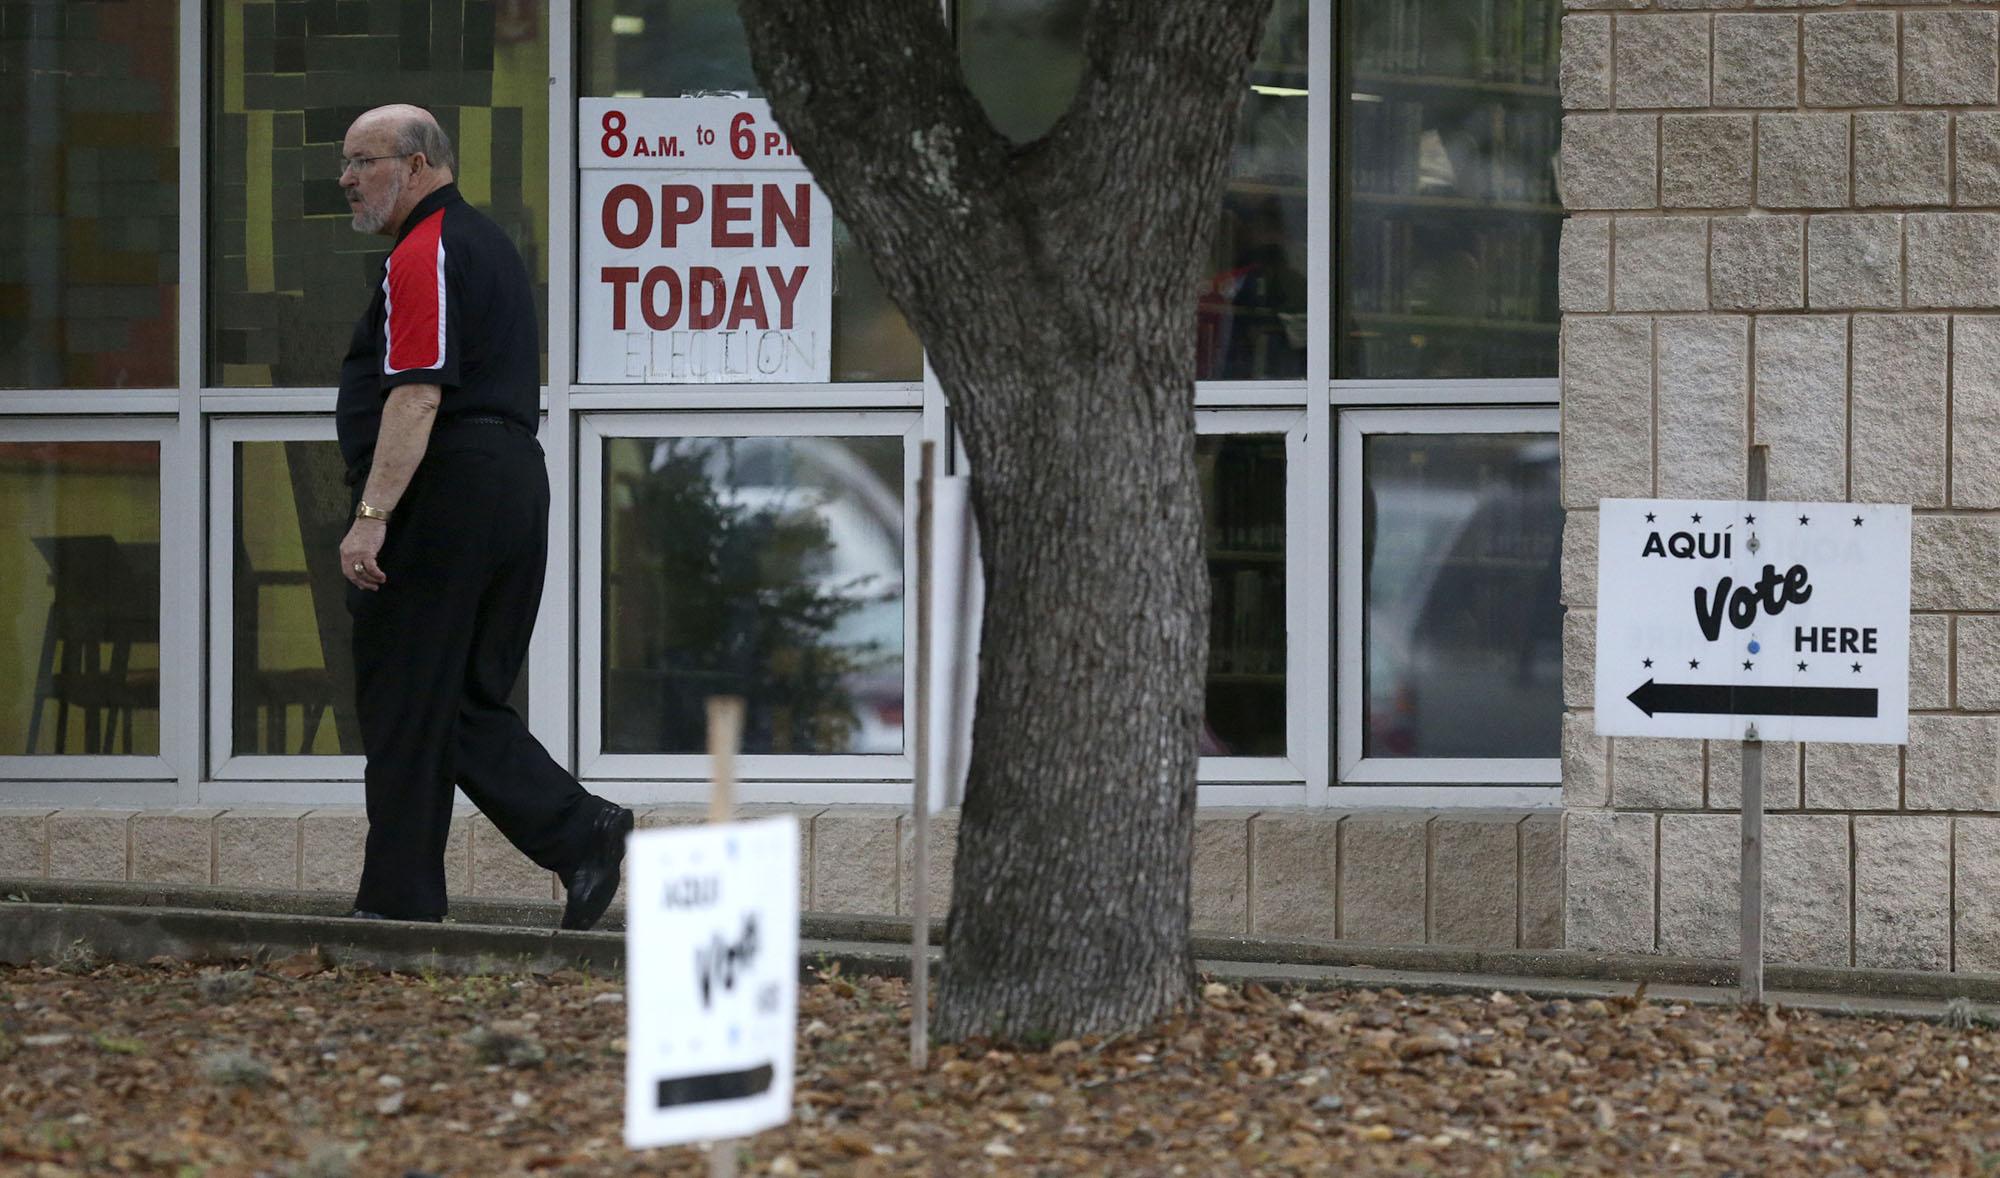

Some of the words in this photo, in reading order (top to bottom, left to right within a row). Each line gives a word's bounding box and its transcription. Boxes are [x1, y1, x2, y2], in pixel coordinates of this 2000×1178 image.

[601, 110, 628, 158] 8
[696, 124, 715, 146] to
[729, 111, 756, 160] 6
[764, 132, 800, 156] P.
[601, 183, 811, 249] OPEN
[601, 265, 809, 331] TODAY
[624, 331, 816, 379] ELECTION
[1641, 523, 1733, 559] AQUÍ
[1694, 564, 1813, 642] Vote
[1794, 626, 1878, 654] HERE
